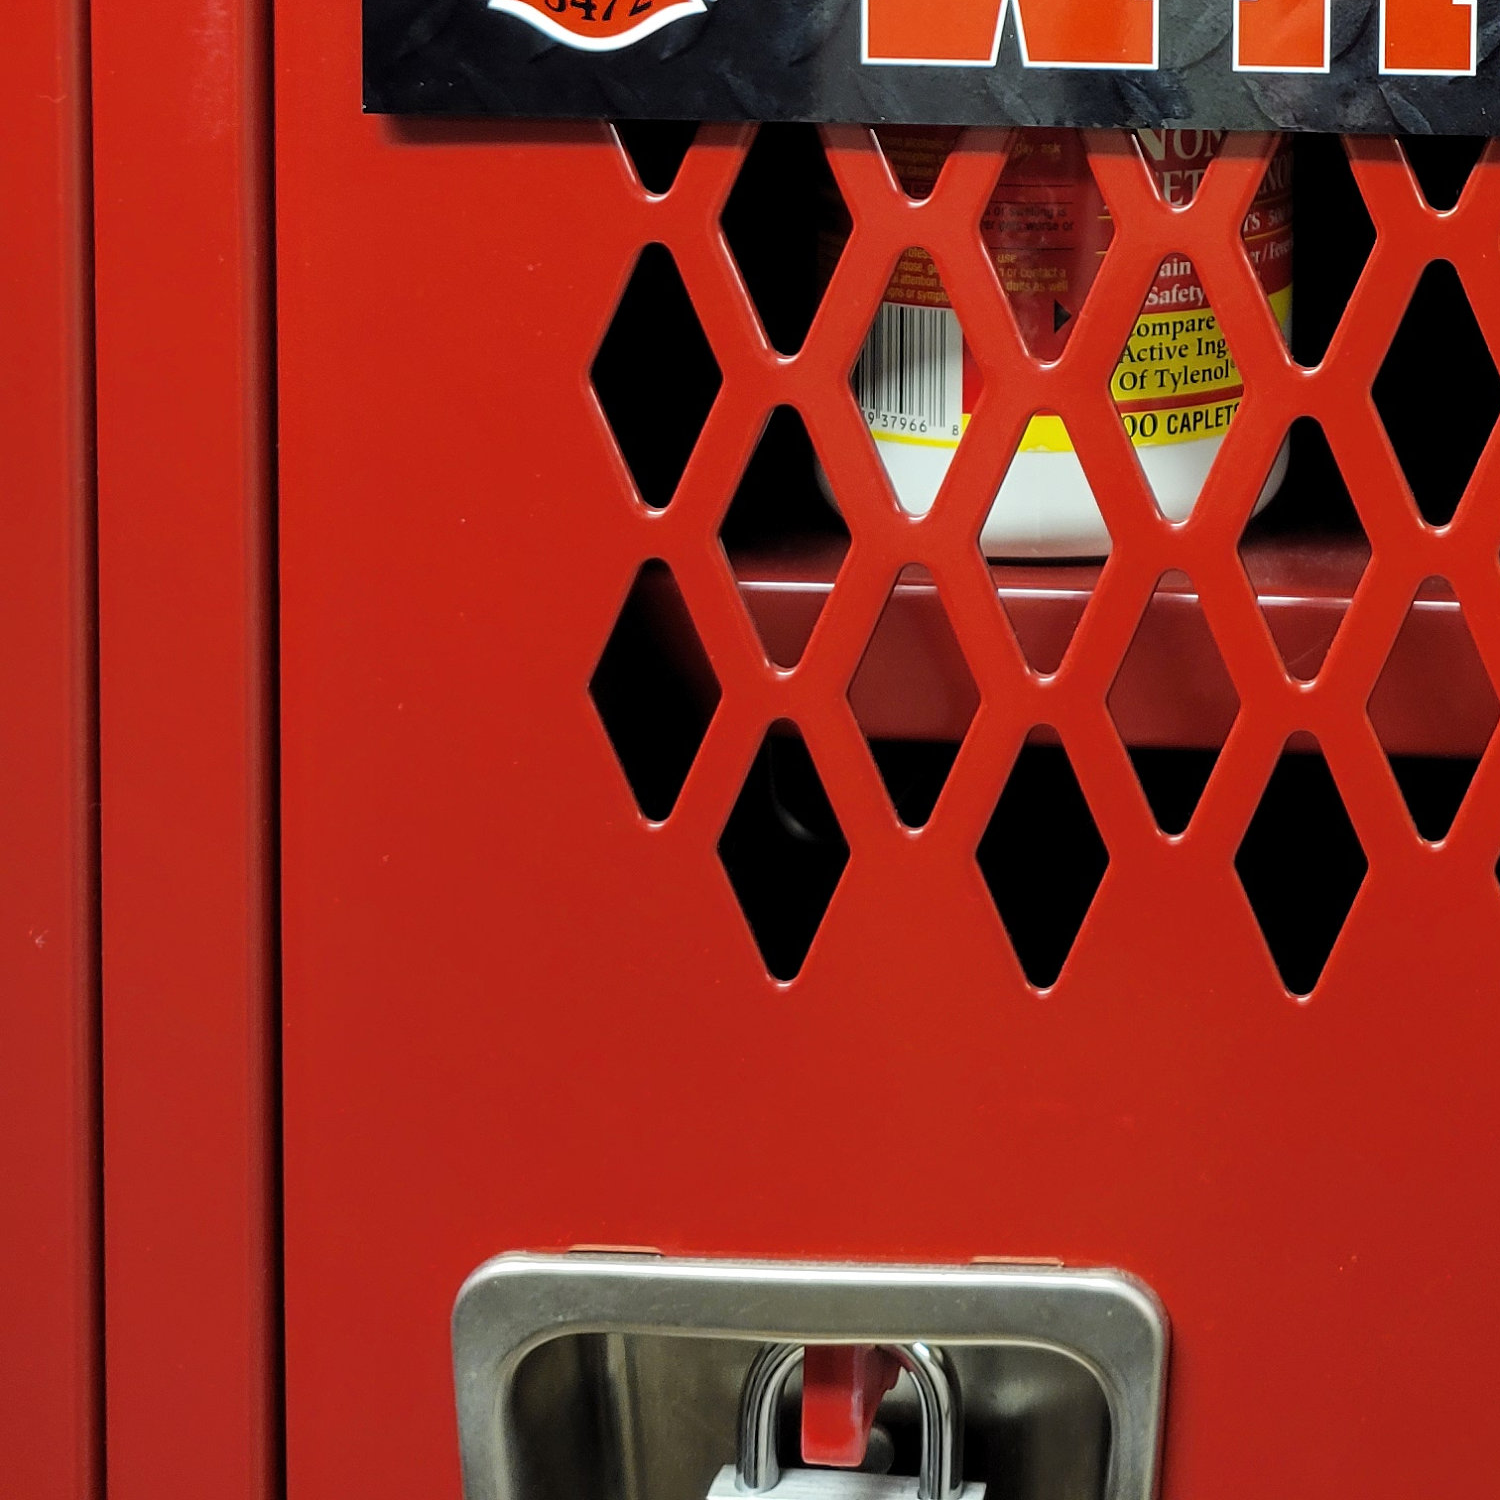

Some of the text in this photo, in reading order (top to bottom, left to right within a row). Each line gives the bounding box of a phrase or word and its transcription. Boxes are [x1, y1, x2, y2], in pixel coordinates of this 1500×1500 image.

[1159, 258, 1191, 277] ain
[1145, 284, 1204, 306] Safety
[1130, 316, 1216, 340] ompare
[1119, 342, 1189, 363] Active
[1119, 369, 1148, 391] Of
